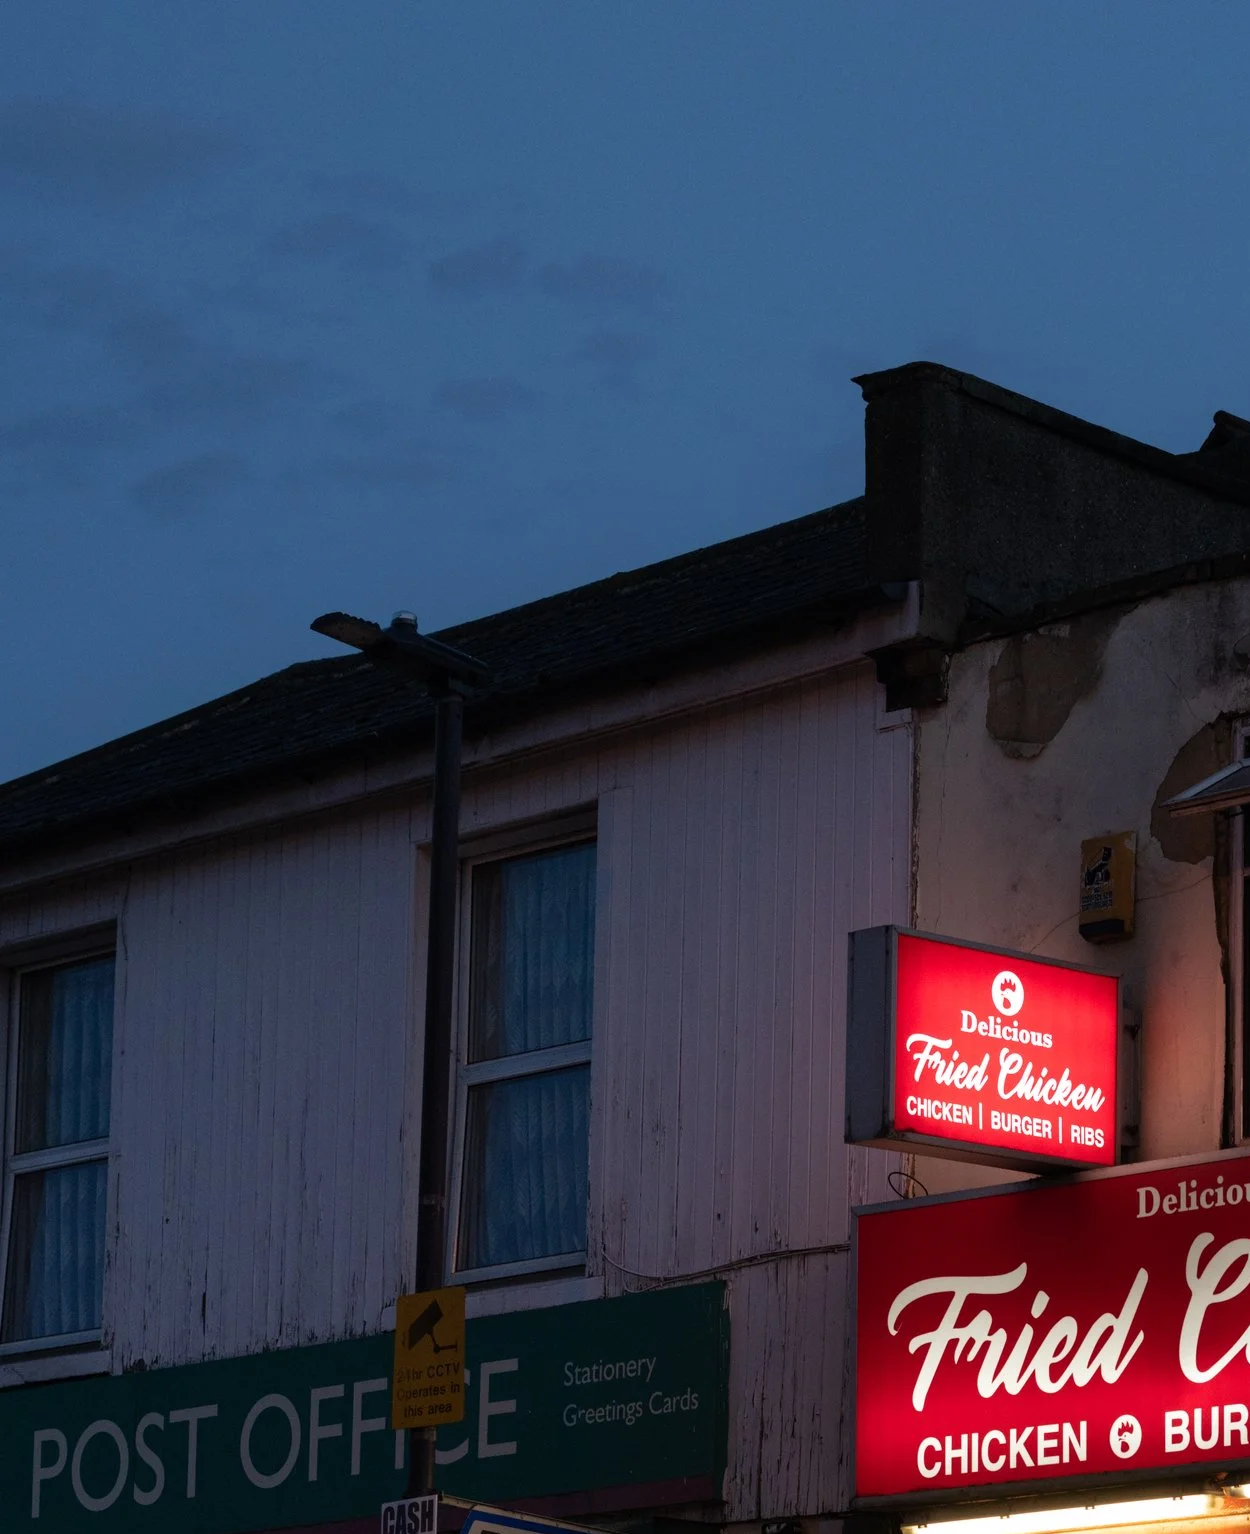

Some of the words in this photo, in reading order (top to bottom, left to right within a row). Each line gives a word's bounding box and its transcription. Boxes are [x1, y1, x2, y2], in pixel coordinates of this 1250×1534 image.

[961, 1009, 1053, 1048] Delicious
[906, 1033, 990, 1091] Fried
[997, 1047, 1105, 1113] Chicken
[906, 1096, 972, 1125] CHICKEN
[991, 1110, 1052, 1139] BURGER
[1071, 1125, 1104, 1148] RIBS
[887, 1261, 1149, 1413] Fried
[427, 1361, 461, 1379] CCTV
[563, 1357, 657, 1388] Stationery
[396, 1385, 446, 1402] Operates
[450, 1381, 460, 1393] in
[404, 1405, 423, 1418] this
[428, 1402, 453, 1416] area
[562, 1398, 643, 1427] Greetings
[649, 1387, 699, 1415] Cards
[30, 1404, 218, 1519] POST
[916, 1418, 1088, 1479] CHICKEN
